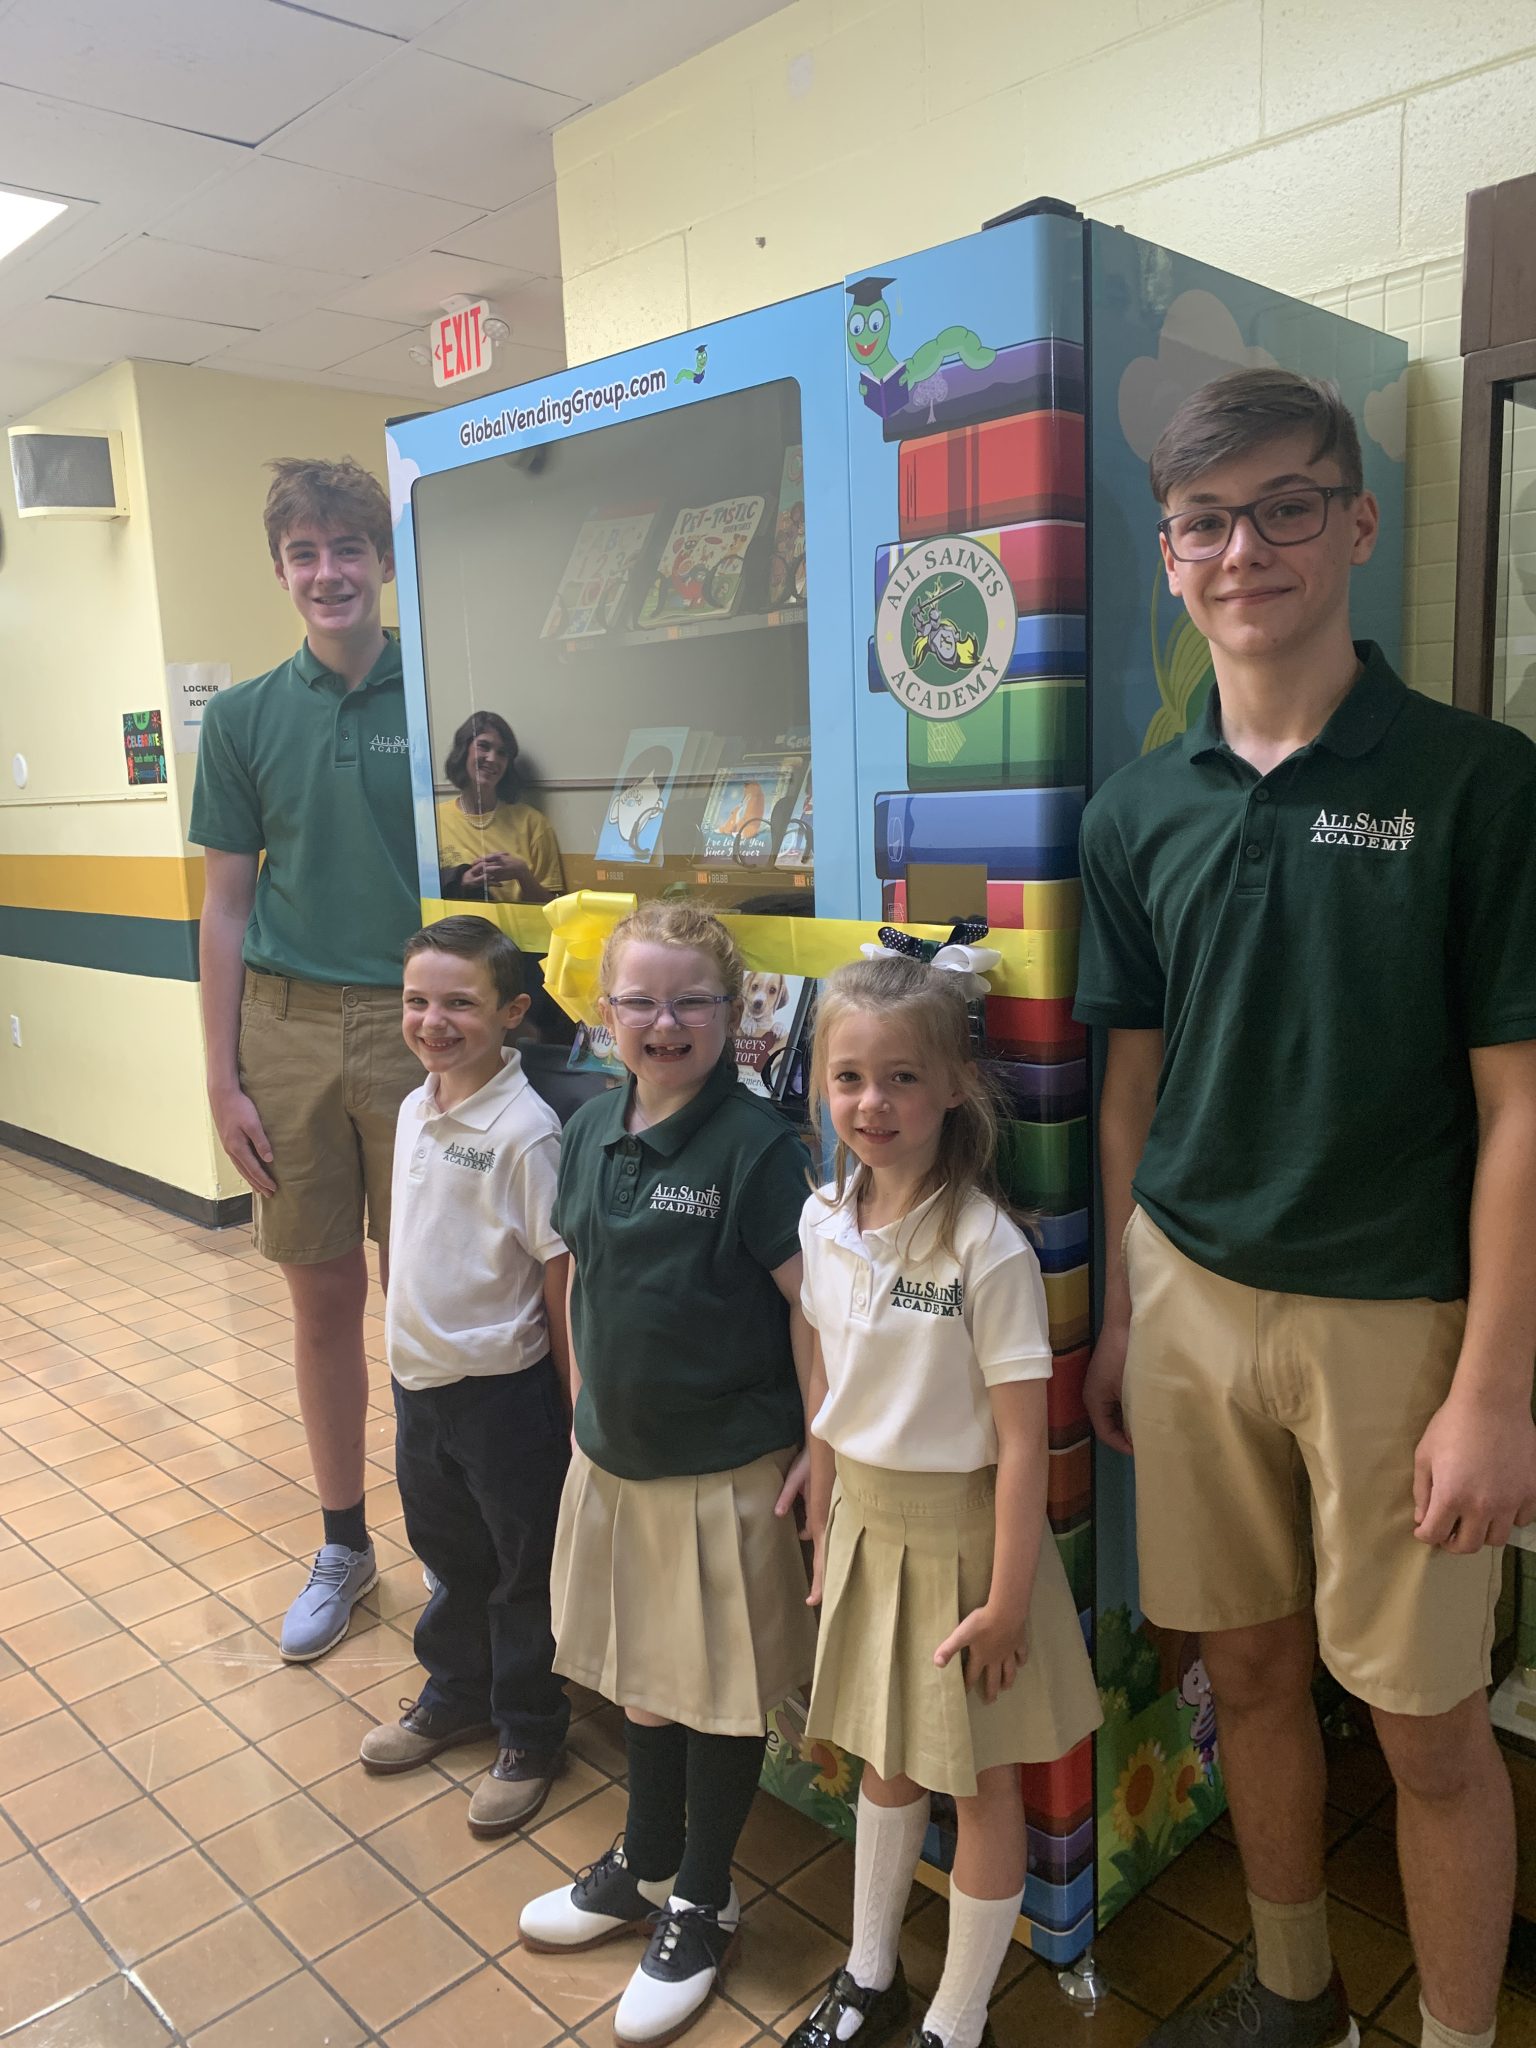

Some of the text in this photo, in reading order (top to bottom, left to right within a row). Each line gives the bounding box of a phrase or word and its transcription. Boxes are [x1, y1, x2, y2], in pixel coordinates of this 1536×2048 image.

[440, 306, 481, 379] EXIT
[460, 370, 666, 446] GlobalVendingGroup.com
[887, 547, 1003, 610] ALL SAINTS
[183, 685, 219, 693] LOCKER
[891, 656, 999, 711] ACADEMY
[189, 699, 208, 707] ROO
[126, 733, 160, 749] CELEBRATE
[369, 744, 407, 754] ACADE
[370, 733, 409, 746] ALL SAI
[1313, 808, 1415, 838] ALL SAINTS
[1310, 831, 1412, 851] ACADEMY
[704, 847, 725, 857] Since
[444, 1141, 466, 1158] ALL
[443, 1154, 495, 1174] ACADEMY
[652, 1183, 721, 1207] ALL SAINTS
[650, 1200, 719, 1219] ACADEMY
[892, 1275, 964, 1305] ALL SAINTS
[891, 1296, 963, 1317] ACADEMY
